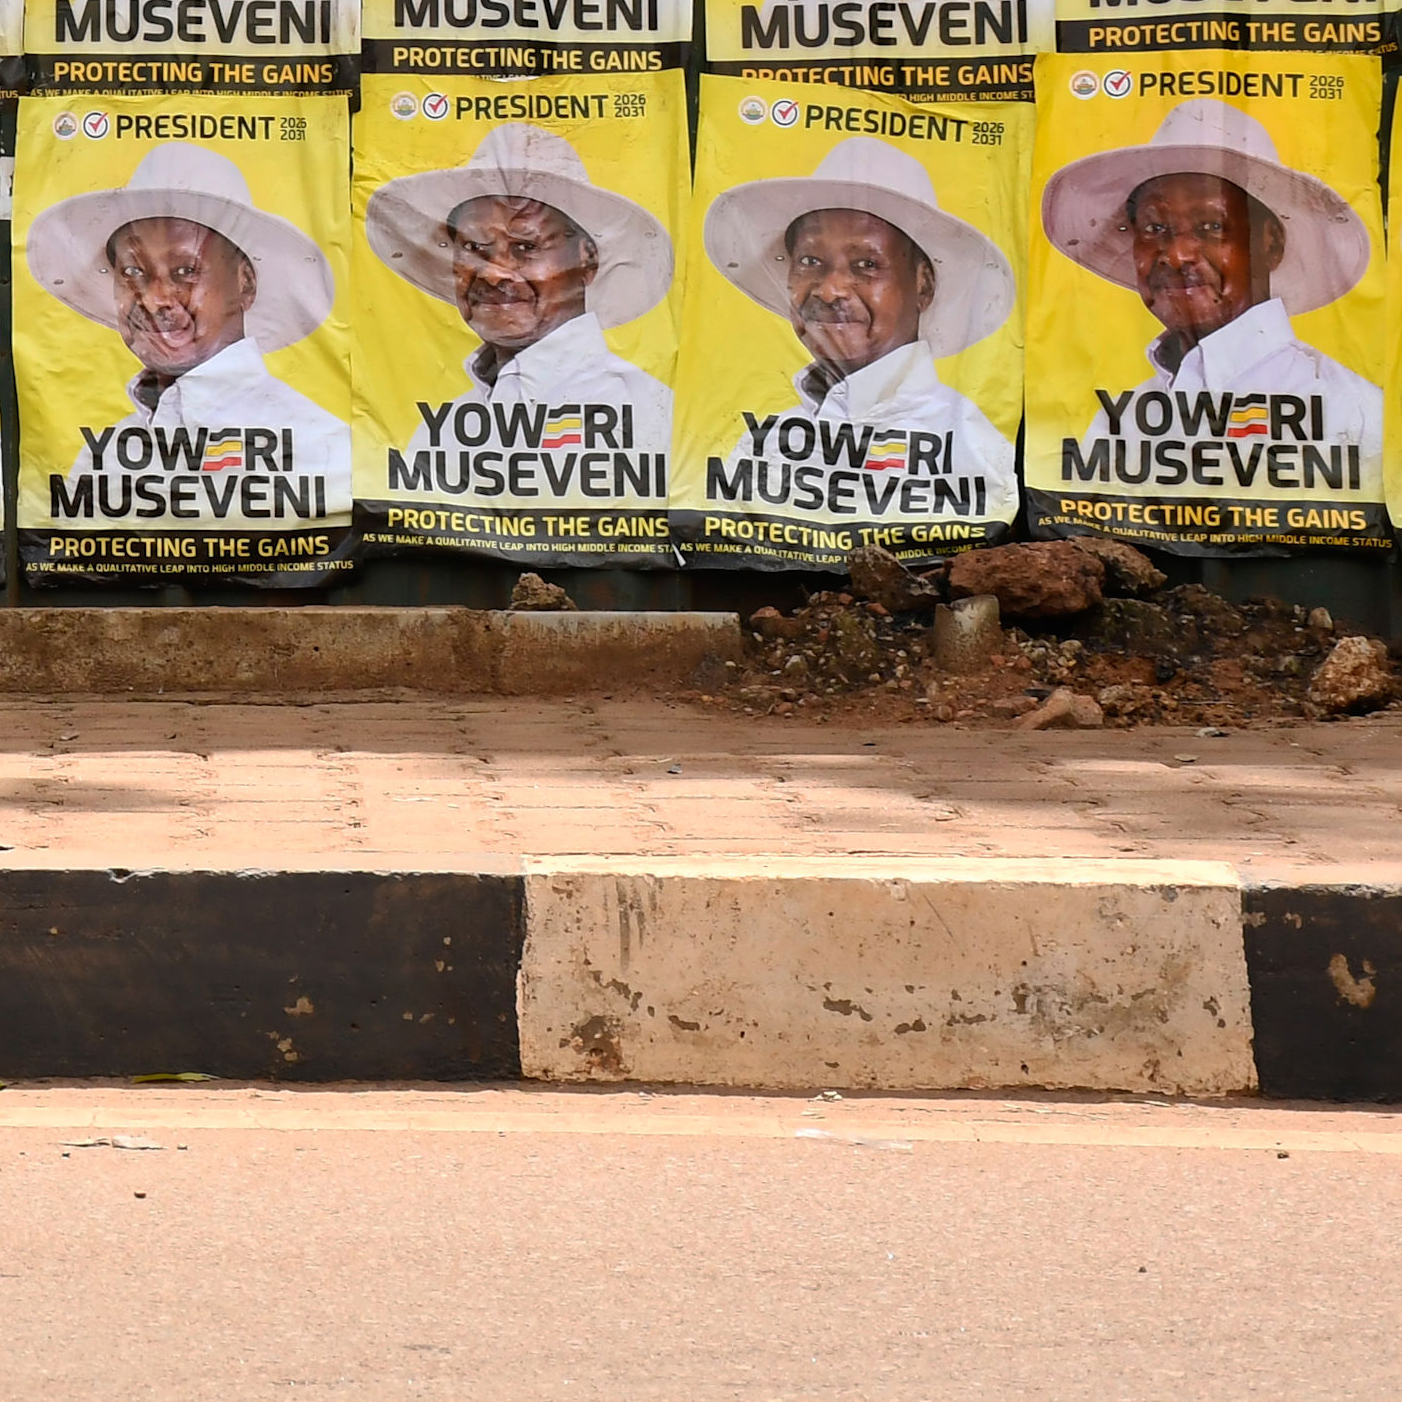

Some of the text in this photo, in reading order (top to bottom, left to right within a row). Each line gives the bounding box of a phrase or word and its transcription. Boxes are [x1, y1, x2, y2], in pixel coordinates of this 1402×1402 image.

[741, 0, 1027, 48] MUSEVENI
[1089, 21, 1381, 47] PROTECTING THE GAINS
[394, 47, 662, 71] PROTECTING THE GAINS
[455, 94, 609, 120] PRESIDENT
[614, 94, 647, 105] 2026
[614, 106, 646, 117] 2031
[417, 402, 633, 449] YOWERI
[1095, 389, 1323, 441] YOWERI
[389, 449, 666, 499] MUSEVENI
[1061, 438, 1360, 490] MUSEVENI
[388, 508, 669, 537] PROTECTING THE GAINS
